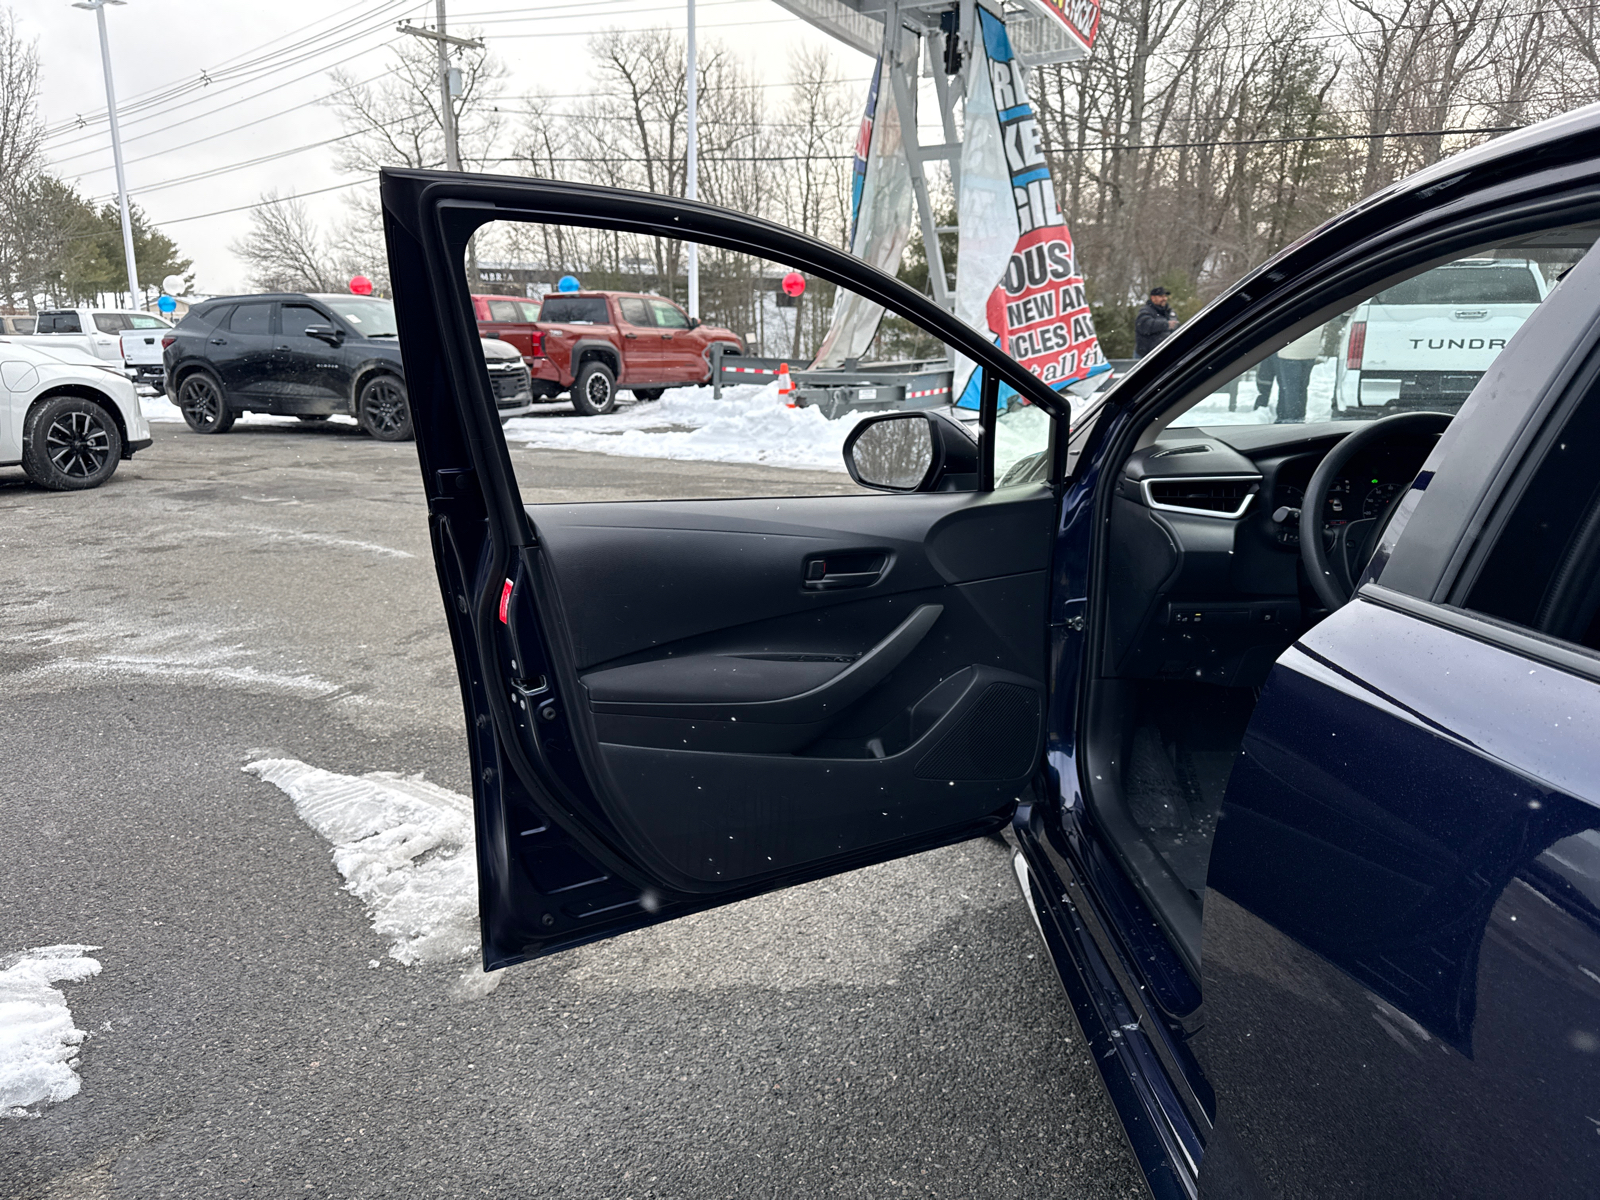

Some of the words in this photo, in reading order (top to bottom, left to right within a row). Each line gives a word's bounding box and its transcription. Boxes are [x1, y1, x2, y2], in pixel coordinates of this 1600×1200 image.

[999, 242, 1081, 294] OUS
[1007, 293, 1055, 328] NEW
[1043, 352, 1076, 381] all
[1083, 342, 1105, 367] ti
[1409, 339, 1507, 350] TUNDR
